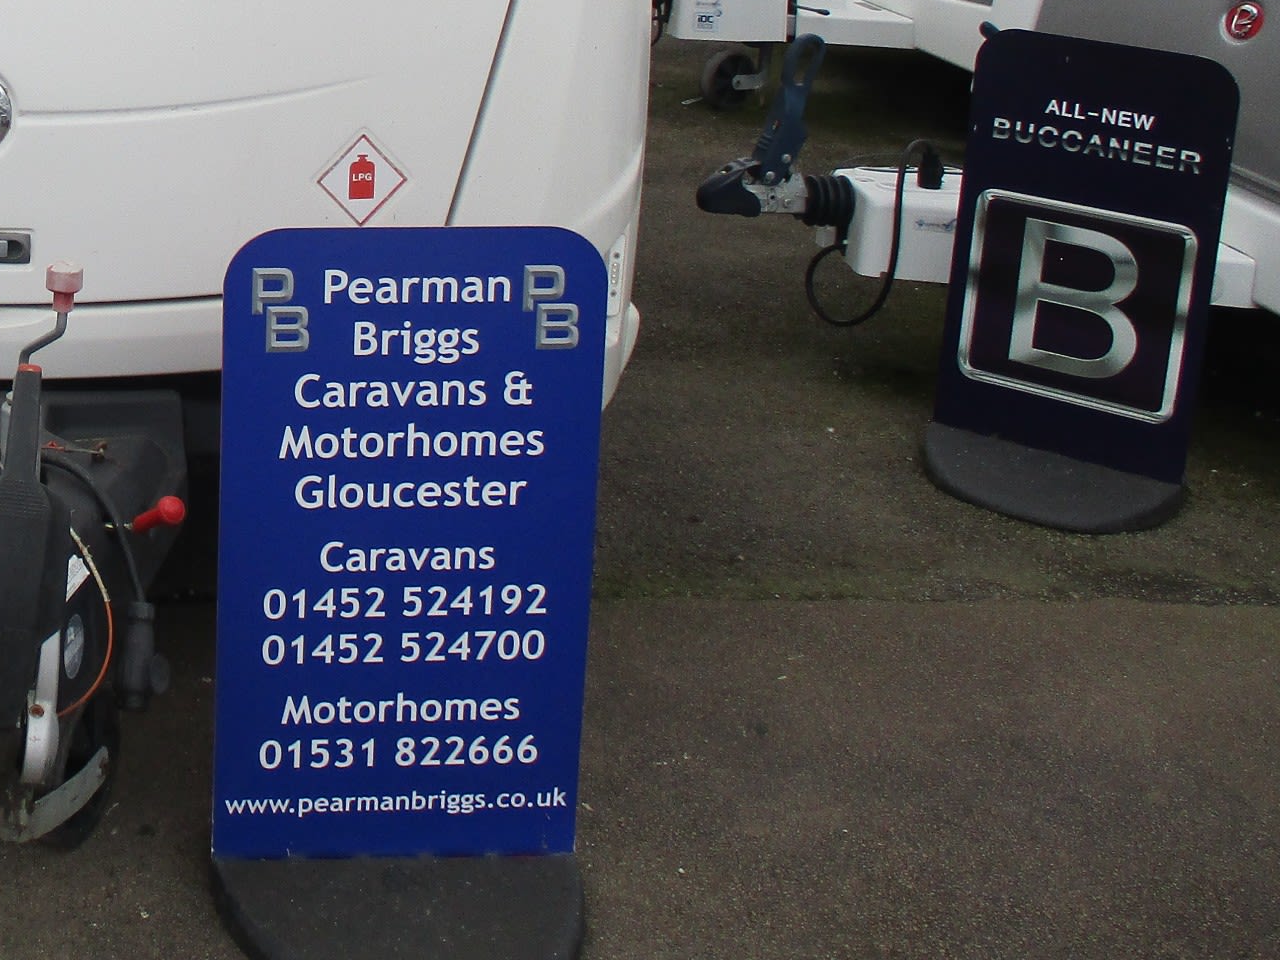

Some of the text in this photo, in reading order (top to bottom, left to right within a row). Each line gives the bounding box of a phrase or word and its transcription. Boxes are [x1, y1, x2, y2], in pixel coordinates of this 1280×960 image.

[1044, 99, 1155, 131] ALL-NEW
[992, 117, 1202, 175] BUCCANEER
[352, 173, 373, 182] LPG
[324, 269, 512, 304] Pearman
[1009, 217, 1139, 379] B
[353, 320, 480, 365] Briggs
[294, 370, 533, 409] Caravans &
[278, 422, 545, 459] Motorhomes
[294, 474, 528, 510] Gloucester
[320, 541, 495, 573] Caravans
[263, 583, 547, 620] 01452 524192
[261, 629, 546, 666] 01452 524700
[281, 692, 520, 725] Motorhomes
[259, 734, 539, 770] 01531 822666
[225, 787, 567, 817] www.pearmanbriggs.co.uk
